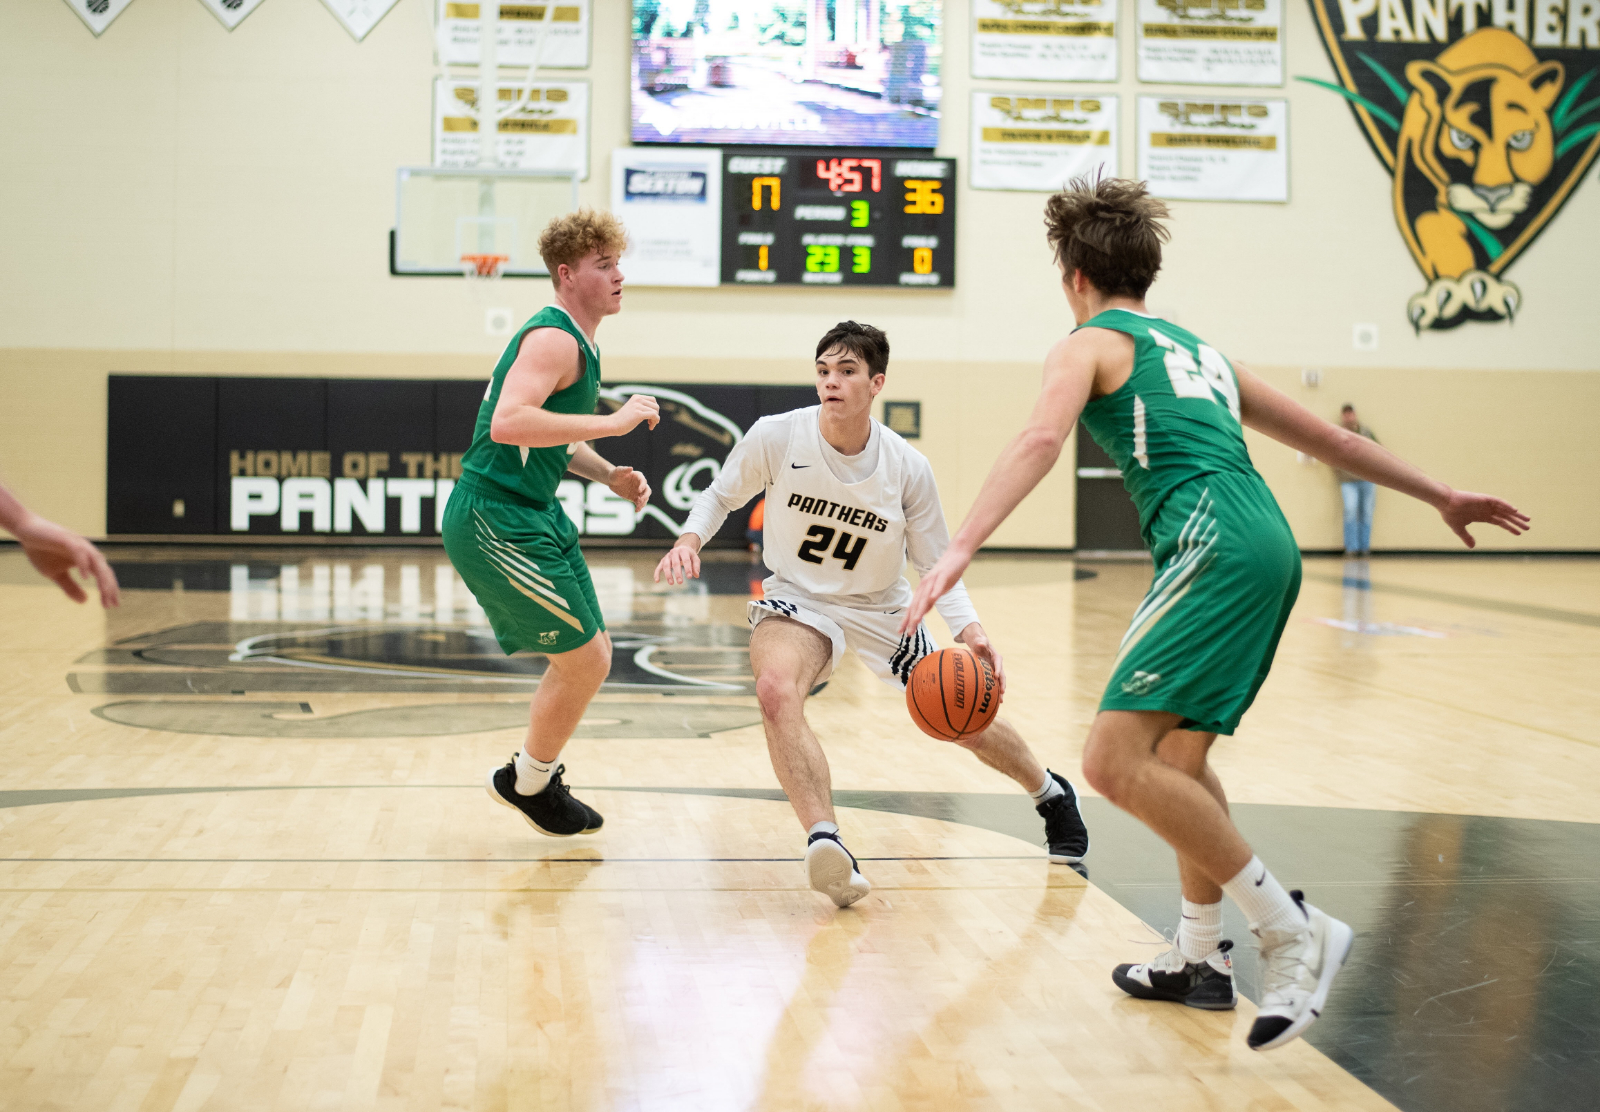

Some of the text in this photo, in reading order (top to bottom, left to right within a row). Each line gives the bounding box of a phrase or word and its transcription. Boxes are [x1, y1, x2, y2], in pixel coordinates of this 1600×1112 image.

[903, 179, 944, 214] 36
[850, 200, 870, 228] 3
[758, 245, 769, 272] 1
[852, 246, 871, 273] 3
[913, 247, 933, 274] 0
[1147, 328, 1242, 425] 24
[230, 451, 331, 478] HOME
[342, 452, 389, 478] OF
[787, 493, 889, 533] PANTHERS
[797, 524, 869, 571] 24
[953, 652, 965, 709] EVOLUTION
